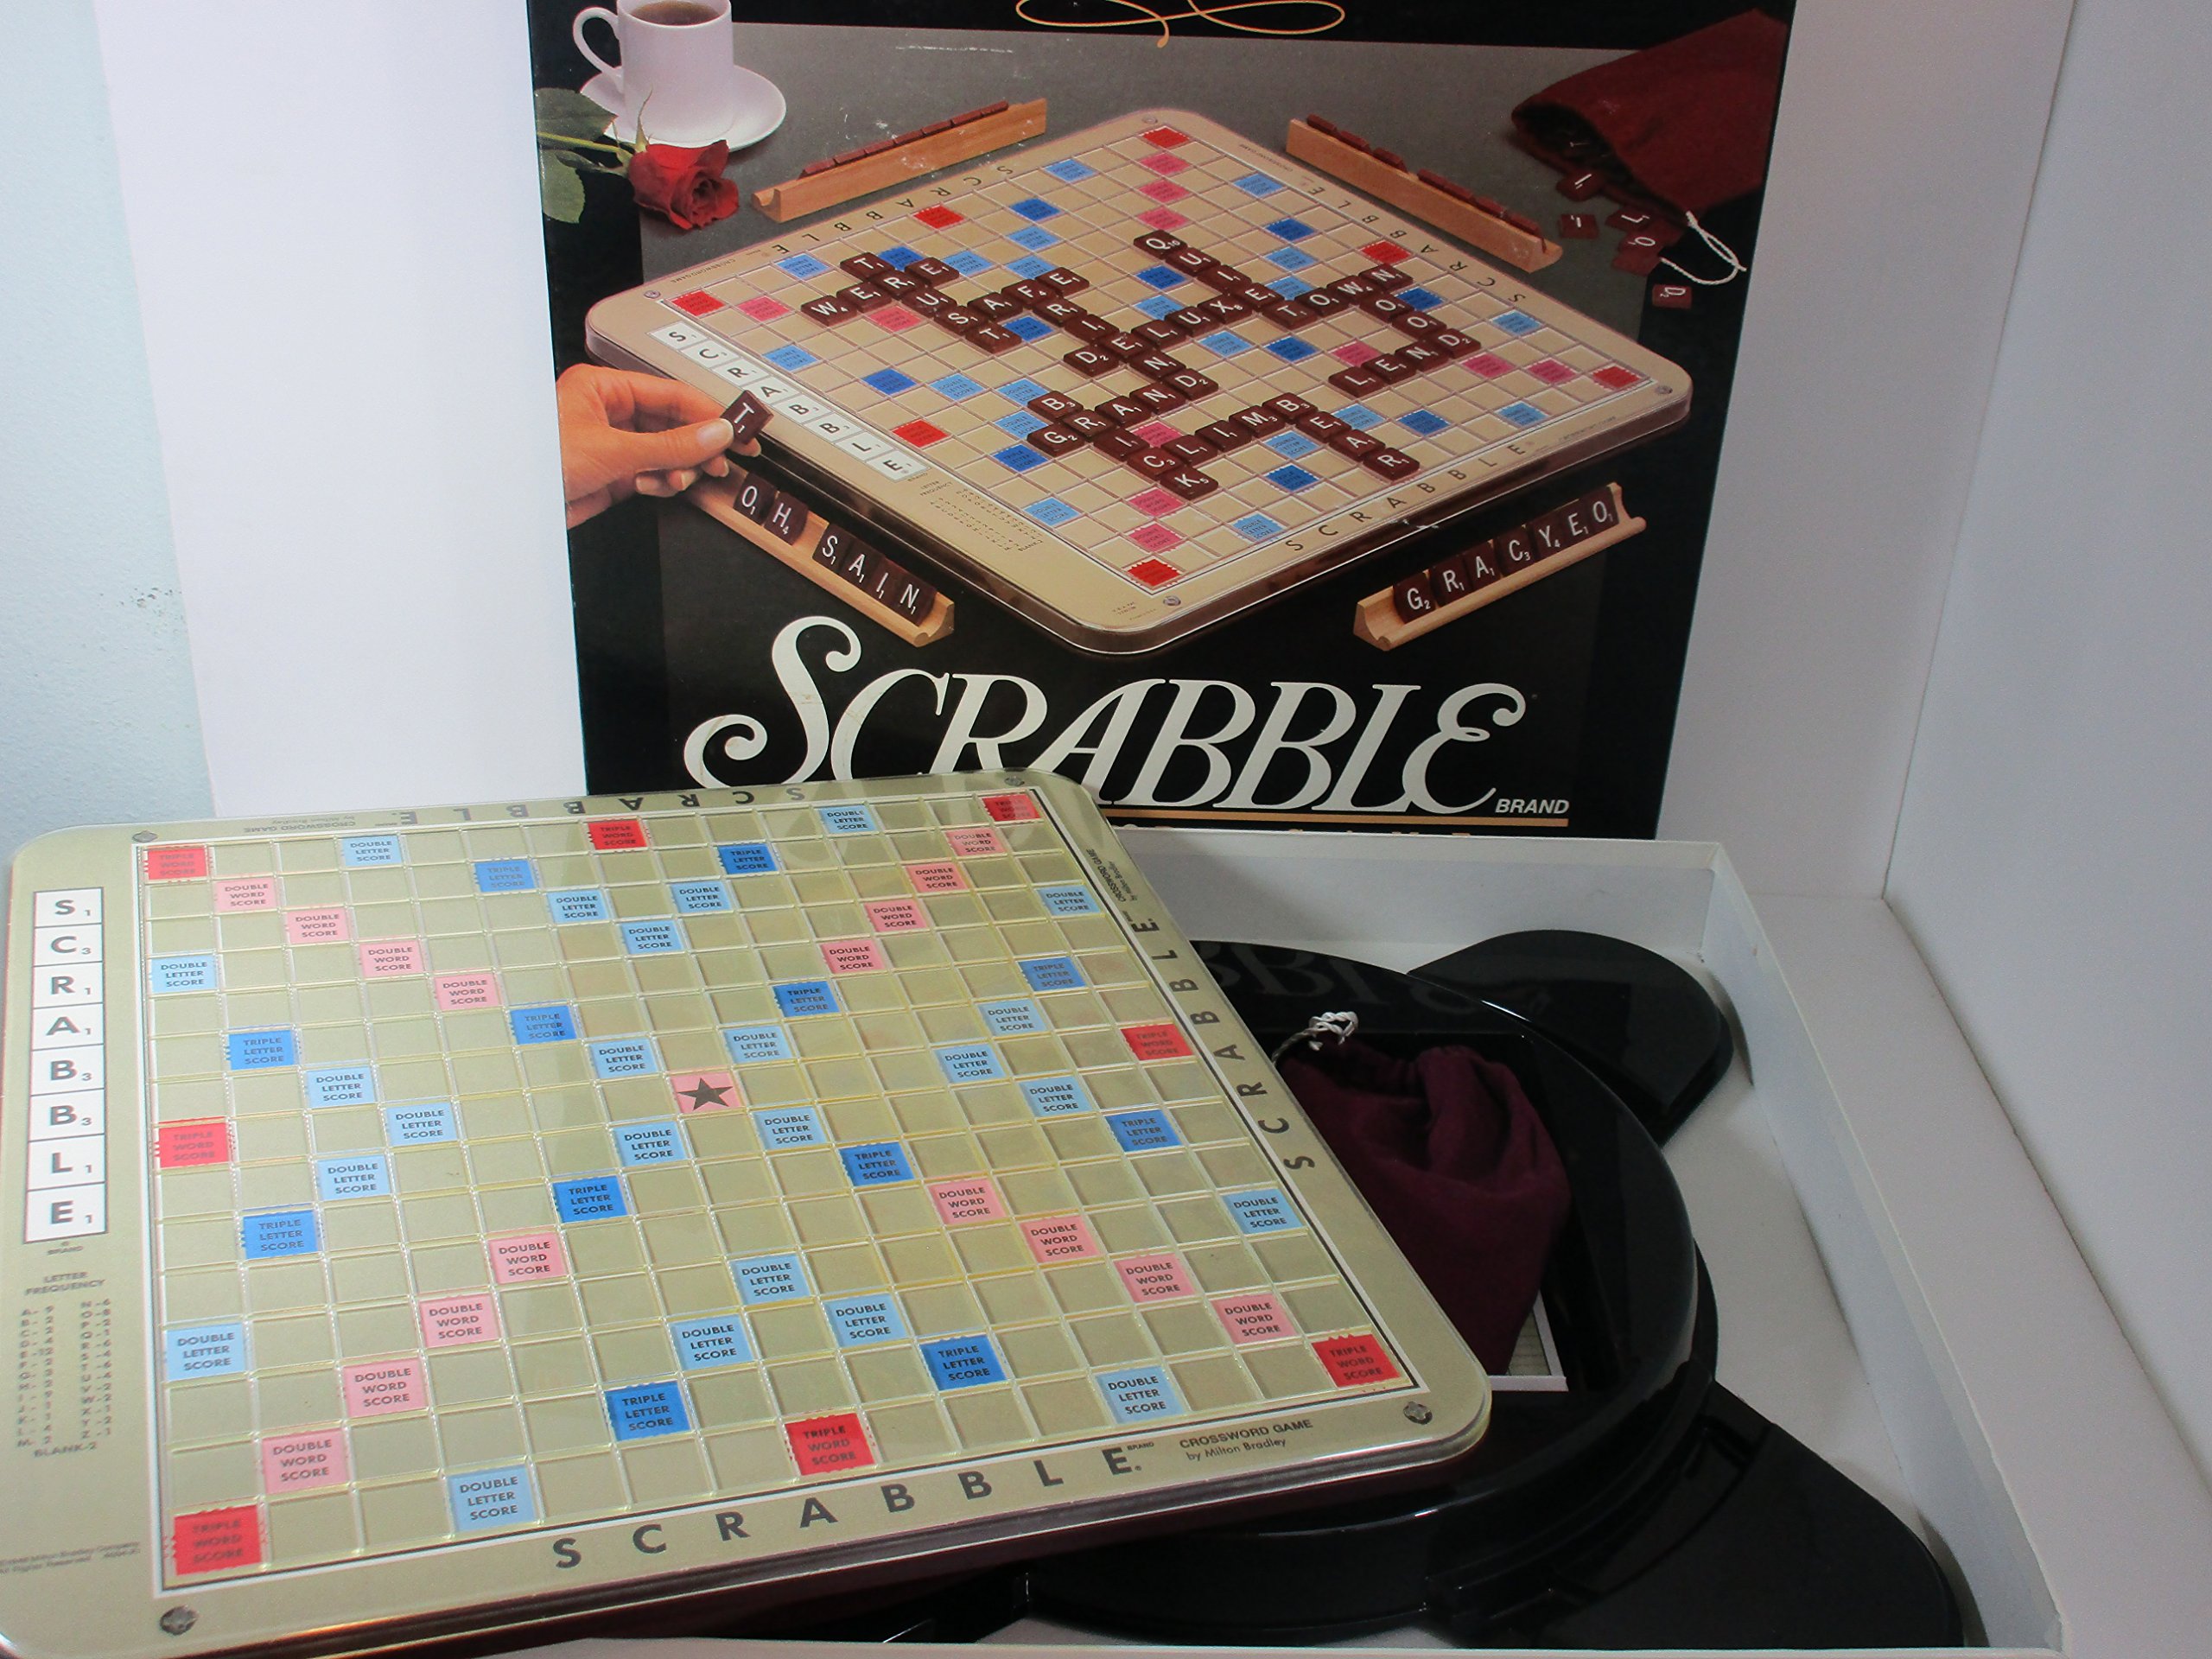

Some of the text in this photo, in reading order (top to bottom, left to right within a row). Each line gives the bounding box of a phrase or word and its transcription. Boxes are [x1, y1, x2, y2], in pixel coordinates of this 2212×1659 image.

[683, 615, 1527, 815] SCRABBLE
[1496, 798, 1570, 815] BRAND
[872, 905, 913, 913] DOUBLE
[160, 962, 207, 970] DOUBLE
[166, 978, 204, 987] SCORE
[790, 995, 825, 1004] LETTER
[987, 1006, 1030, 1015] DOUBLE
[995, 1014, 1030, 1023] LETTER
[999, 1023, 1035, 1032] SCORE
[598, 1045, 645, 1055] DOUBLE
[944, 1051, 988, 1061] DOUBLE
[605, 1054, 643, 1063] LETTER
[952, 1060, 988, 1069] LETTER
[607, 1063, 645, 1072] SCORE
[957, 1068, 993, 1077] SCORE
[315, 1072, 365, 1084] DOUBLE
[321, 1083, 361, 1092] LETTER
[1028, 1084, 1073, 1095] DOUBLE
[322, 1091, 363, 1102] SCORE
[1038, 1094, 1074, 1103] LETTER
[1042, 1103, 1079, 1112] SCORE
[763, 1115, 810, 1126] DOUBLE
[623, 1129, 671, 1141] DOUBLE
[771, 1124, 810, 1135] LETTER
[631, 1140, 671, 1150] LETTER
[775, 1134, 814, 1144] SCORE
[633, 1149, 673, 1160] SCORE
[854, 1150, 892, 1160] TRIPLE
[858, 1160, 896, 1170] LETTER
[862, 1169, 900, 1179] SCORE
[568, 1184, 607, 1195] TRIPLE
[938, 1186, 986, 1198] DOUBLE
[570, 1194, 611, 1205] LETTER
[947, 1197, 986, 1208] WORD
[1232, 1197, 1279, 1209] DOUBLE
[573, 1205, 613, 1215] SCORE
[951, 1207, 990, 1218] SCORE
[1243, 1207, 1281, 1217] LETTER
[1249, 1217, 1287, 1228] SCORE
[498, 1242, 550, 1255] DOUBLE
[505, 1253, 548, 1265] WORD
[507, 1264, 550, 1276] SCORE
[741, 1262, 791, 1275] DOUBLE
[1124, 1262, 1173, 1274] DOUBLE
[44, 1271, 90, 1284] LETTER
[749, 1274, 791, 1286] LETTER
[1135, 1273, 1175, 1285] WORD
[24, 1279, 105, 1296] FREQUENCY
[753, 1284, 795, 1297] SCORE
[1140, 1283, 1180, 1296] SCORE
[835, 1303, 887, 1317] DOUBLE
[844, 1315, 887, 1327] LETTER
[681, 1324, 734, 1338] DOUBLE
[849, 1326, 891, 1339] SCORE
[690, 1337, 733, 1350] LETTER
[693, 1348, 737, 1362] SCORE
[938, 1344, 979, 1357] TRIPLE
[942, 1357, 985, 1370] LETTER
[353, 1367, 410, 1382] DOUBLE
[947, 1369, 990, 1382] SCORE
[361, 1380, 408, 1395] WORD
[1107, 1376, 1159, 1390] DOUBLE
[362, 1393, 409, 1408] SCORE
[621, 1392, 666, 1407] TRIPLE
[1117, 1389, 1160, 1402] LETTER
[625, 1405, 670, 1419] LETTER
[1123, 1401, 1166, 1414] SCORE
[628, 1418, 673, 1432] SCORE
[802, 1426, 846, 1440] TRIPLE
[1179, 1419, 1313, 1449] CROSSWORD GAME
[806, 1438, 852, 1453] WORD
[1127, 1441, 1154, 1452] BRAND
[1185, 1437, 1287, 1462] by Milton Bradley
[810, 1451, 856, 1466] SCORE
[459, 1476, 518, 1493] DOUBLE
[467, 1491, 515, 1506] LETTER
[469, 1504, 518, 1521] SCORE
